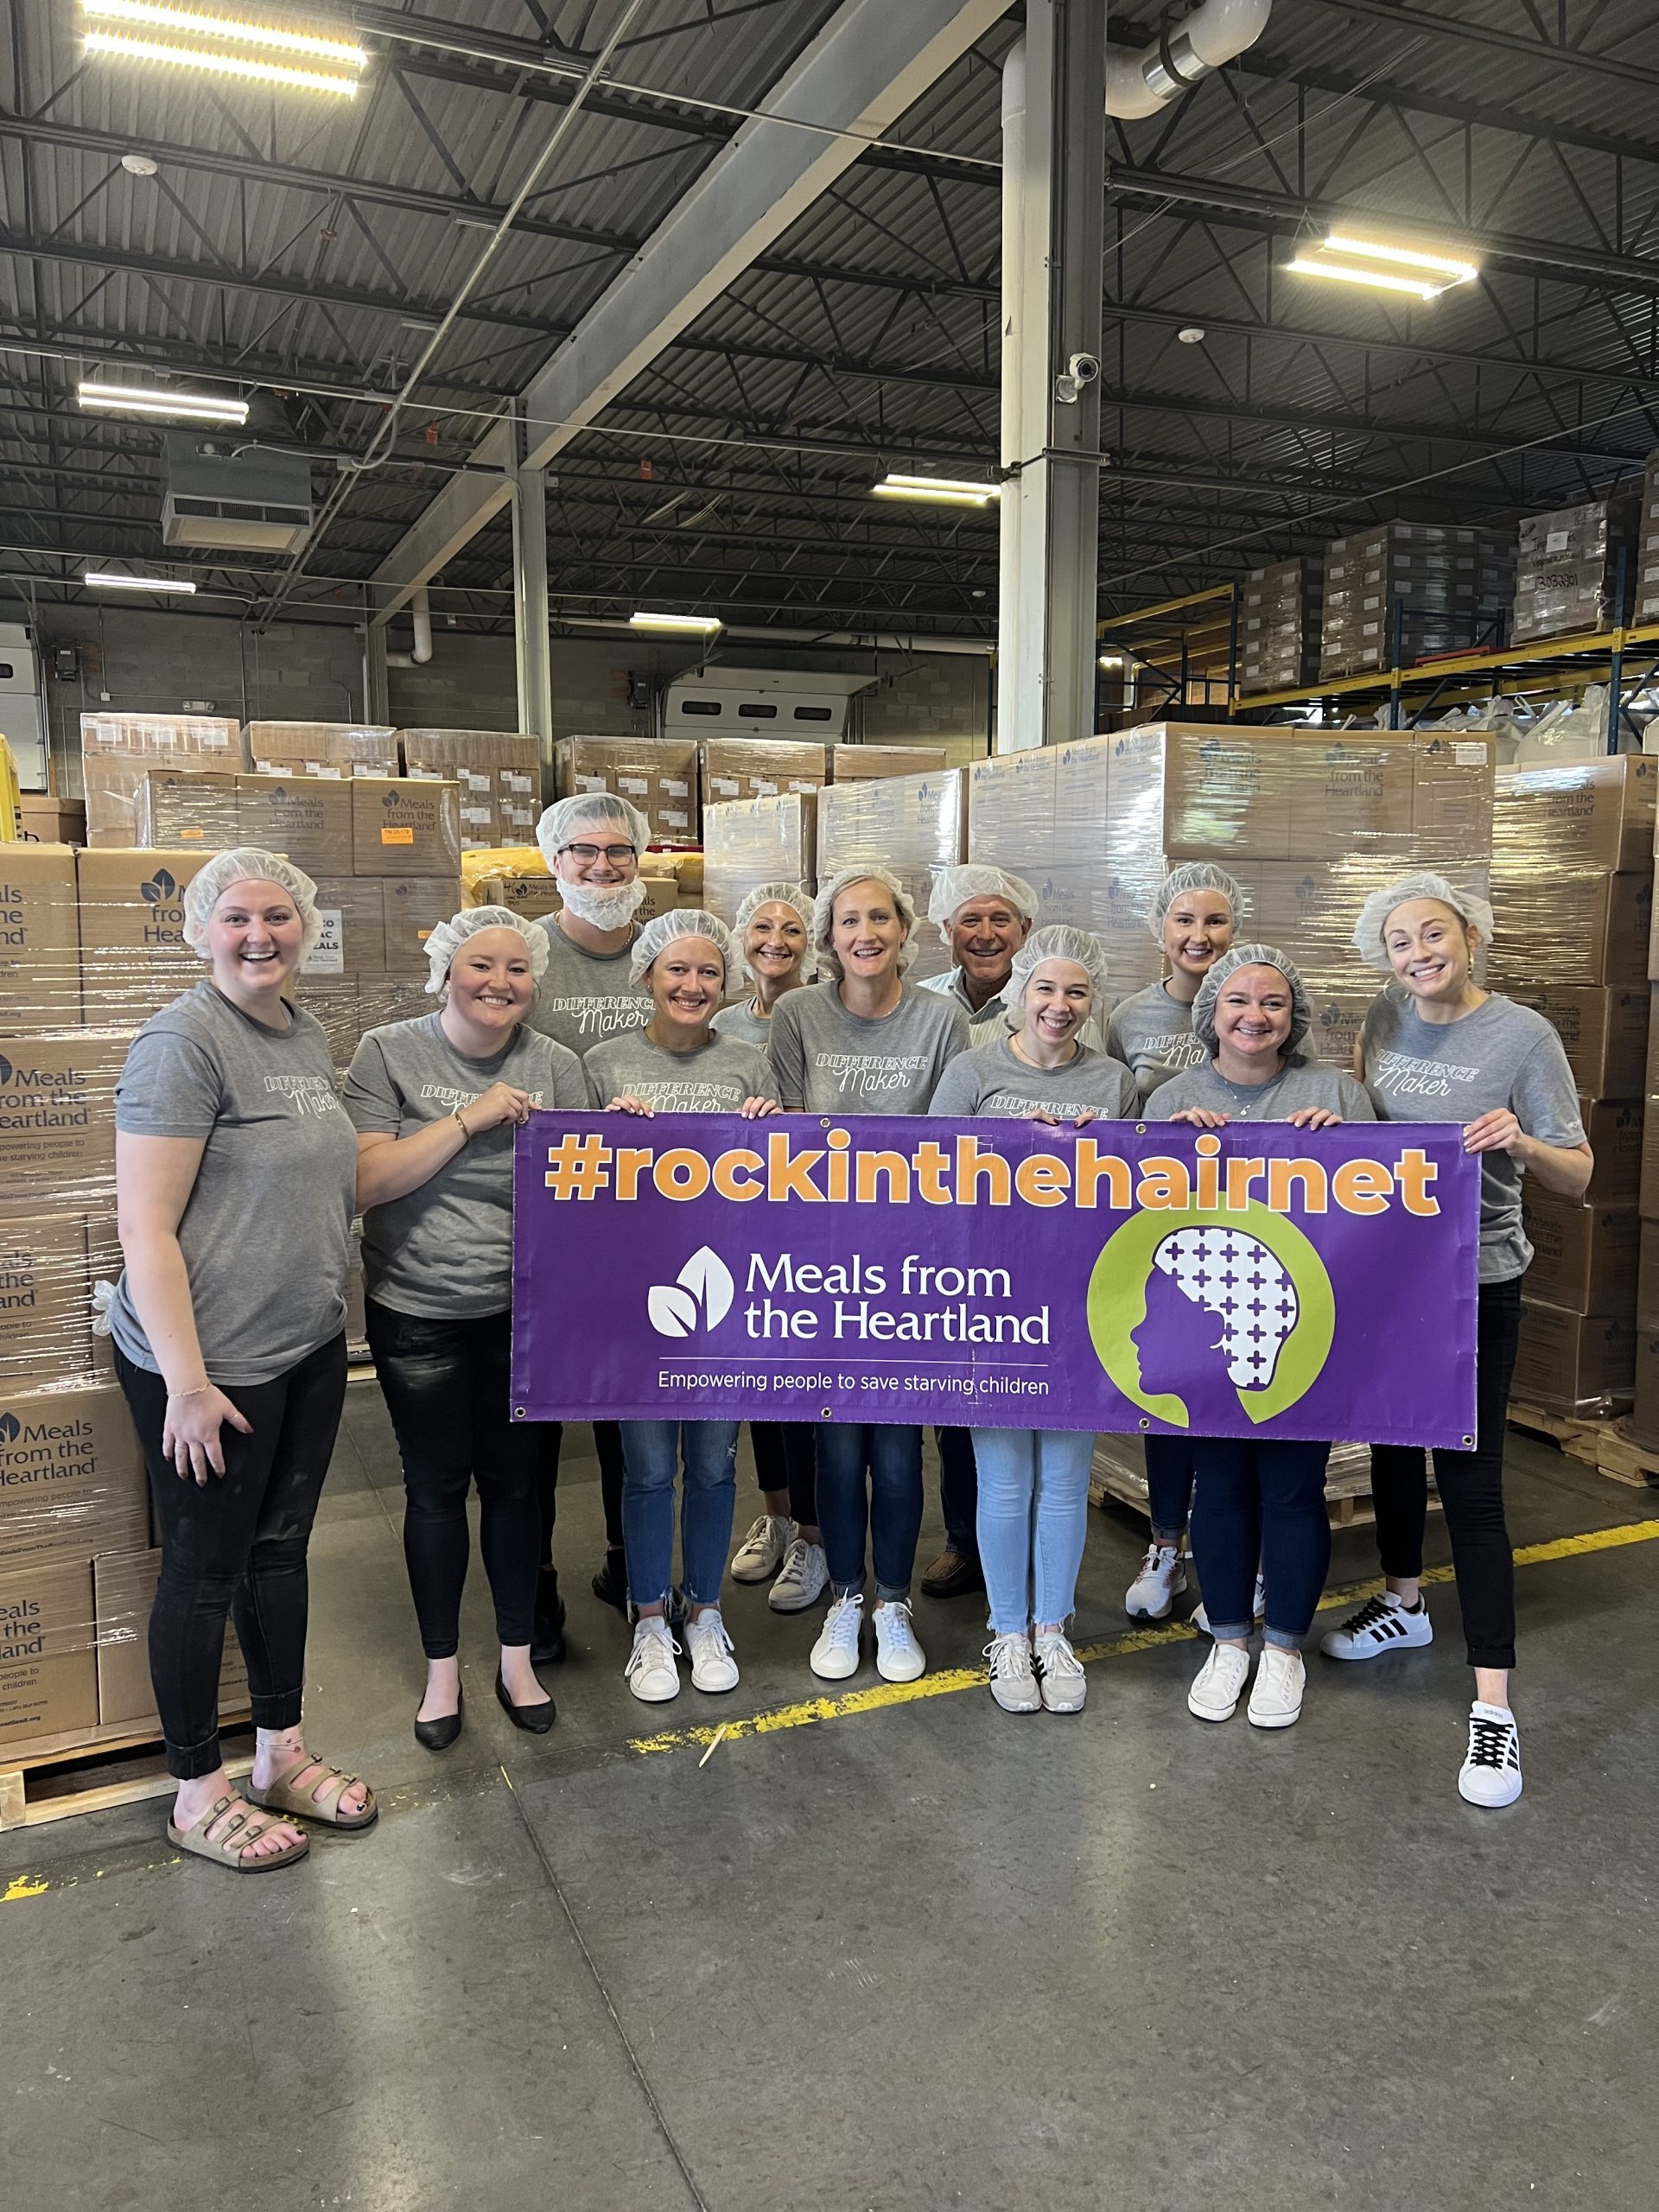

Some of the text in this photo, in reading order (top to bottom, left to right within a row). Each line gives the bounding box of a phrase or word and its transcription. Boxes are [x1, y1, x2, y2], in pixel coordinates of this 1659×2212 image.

[1331, 769, 1383, 782] from the
[1325, 784, 1383, 797] Heartland
[1576, 792, 1594, 804] the
[305, 808, 324, 819] the
[401, 798, 435, 810] Meals
[387, 809, 435, 821] from the
[639, 906, 656, 916] the
[642, 897, 656, 906] als
[0, 909, 22, 924] he
[152, 906, 185, 922] fro
[553, 996, 656, 1012] DIFFERENC
[571, 1009, 648, 1038] Maker
[816, 1052, 928, 1071] DIFFERENCE
[1375, 1048, 1480, 1082] DIFFERENCE
[15, 1068, 86, 1088] Meals
[832, 1068, 911, 1097] Maker
[1373, 1065, 1452, 1096] Maker
[0, 1088, 87, 1109] rom the
[622, 1082, 741, 1102] DIFFERENCE
[0, 1109, 88, 1129] eartland
[0, 1141, 41, 1151] powering
[43, 1140, 74, 1150] people
[10, 1153, 46, 1161] starving
[544, 1128, 1441, 1217] #rockinthehairnet
[744, 1253, 1012, 1298] Meals from
[743, 1299, 1051, 1345] the Heartland
[658, 1372, 1050, 1396] Empowering people to save starving children
[23, 1420, 93, 1444] Meals
[58, 1440, 94, 1459] the
[0, 1458, 95, 1487] eartland
[0, 1495, 49, 1508] mpowering
[51, 1491, 80, 1502] people
[0, 1599, 41, 1621] eals
[3, 1621, 41, 1639] the
[3, 1679, 37, 1691] children
